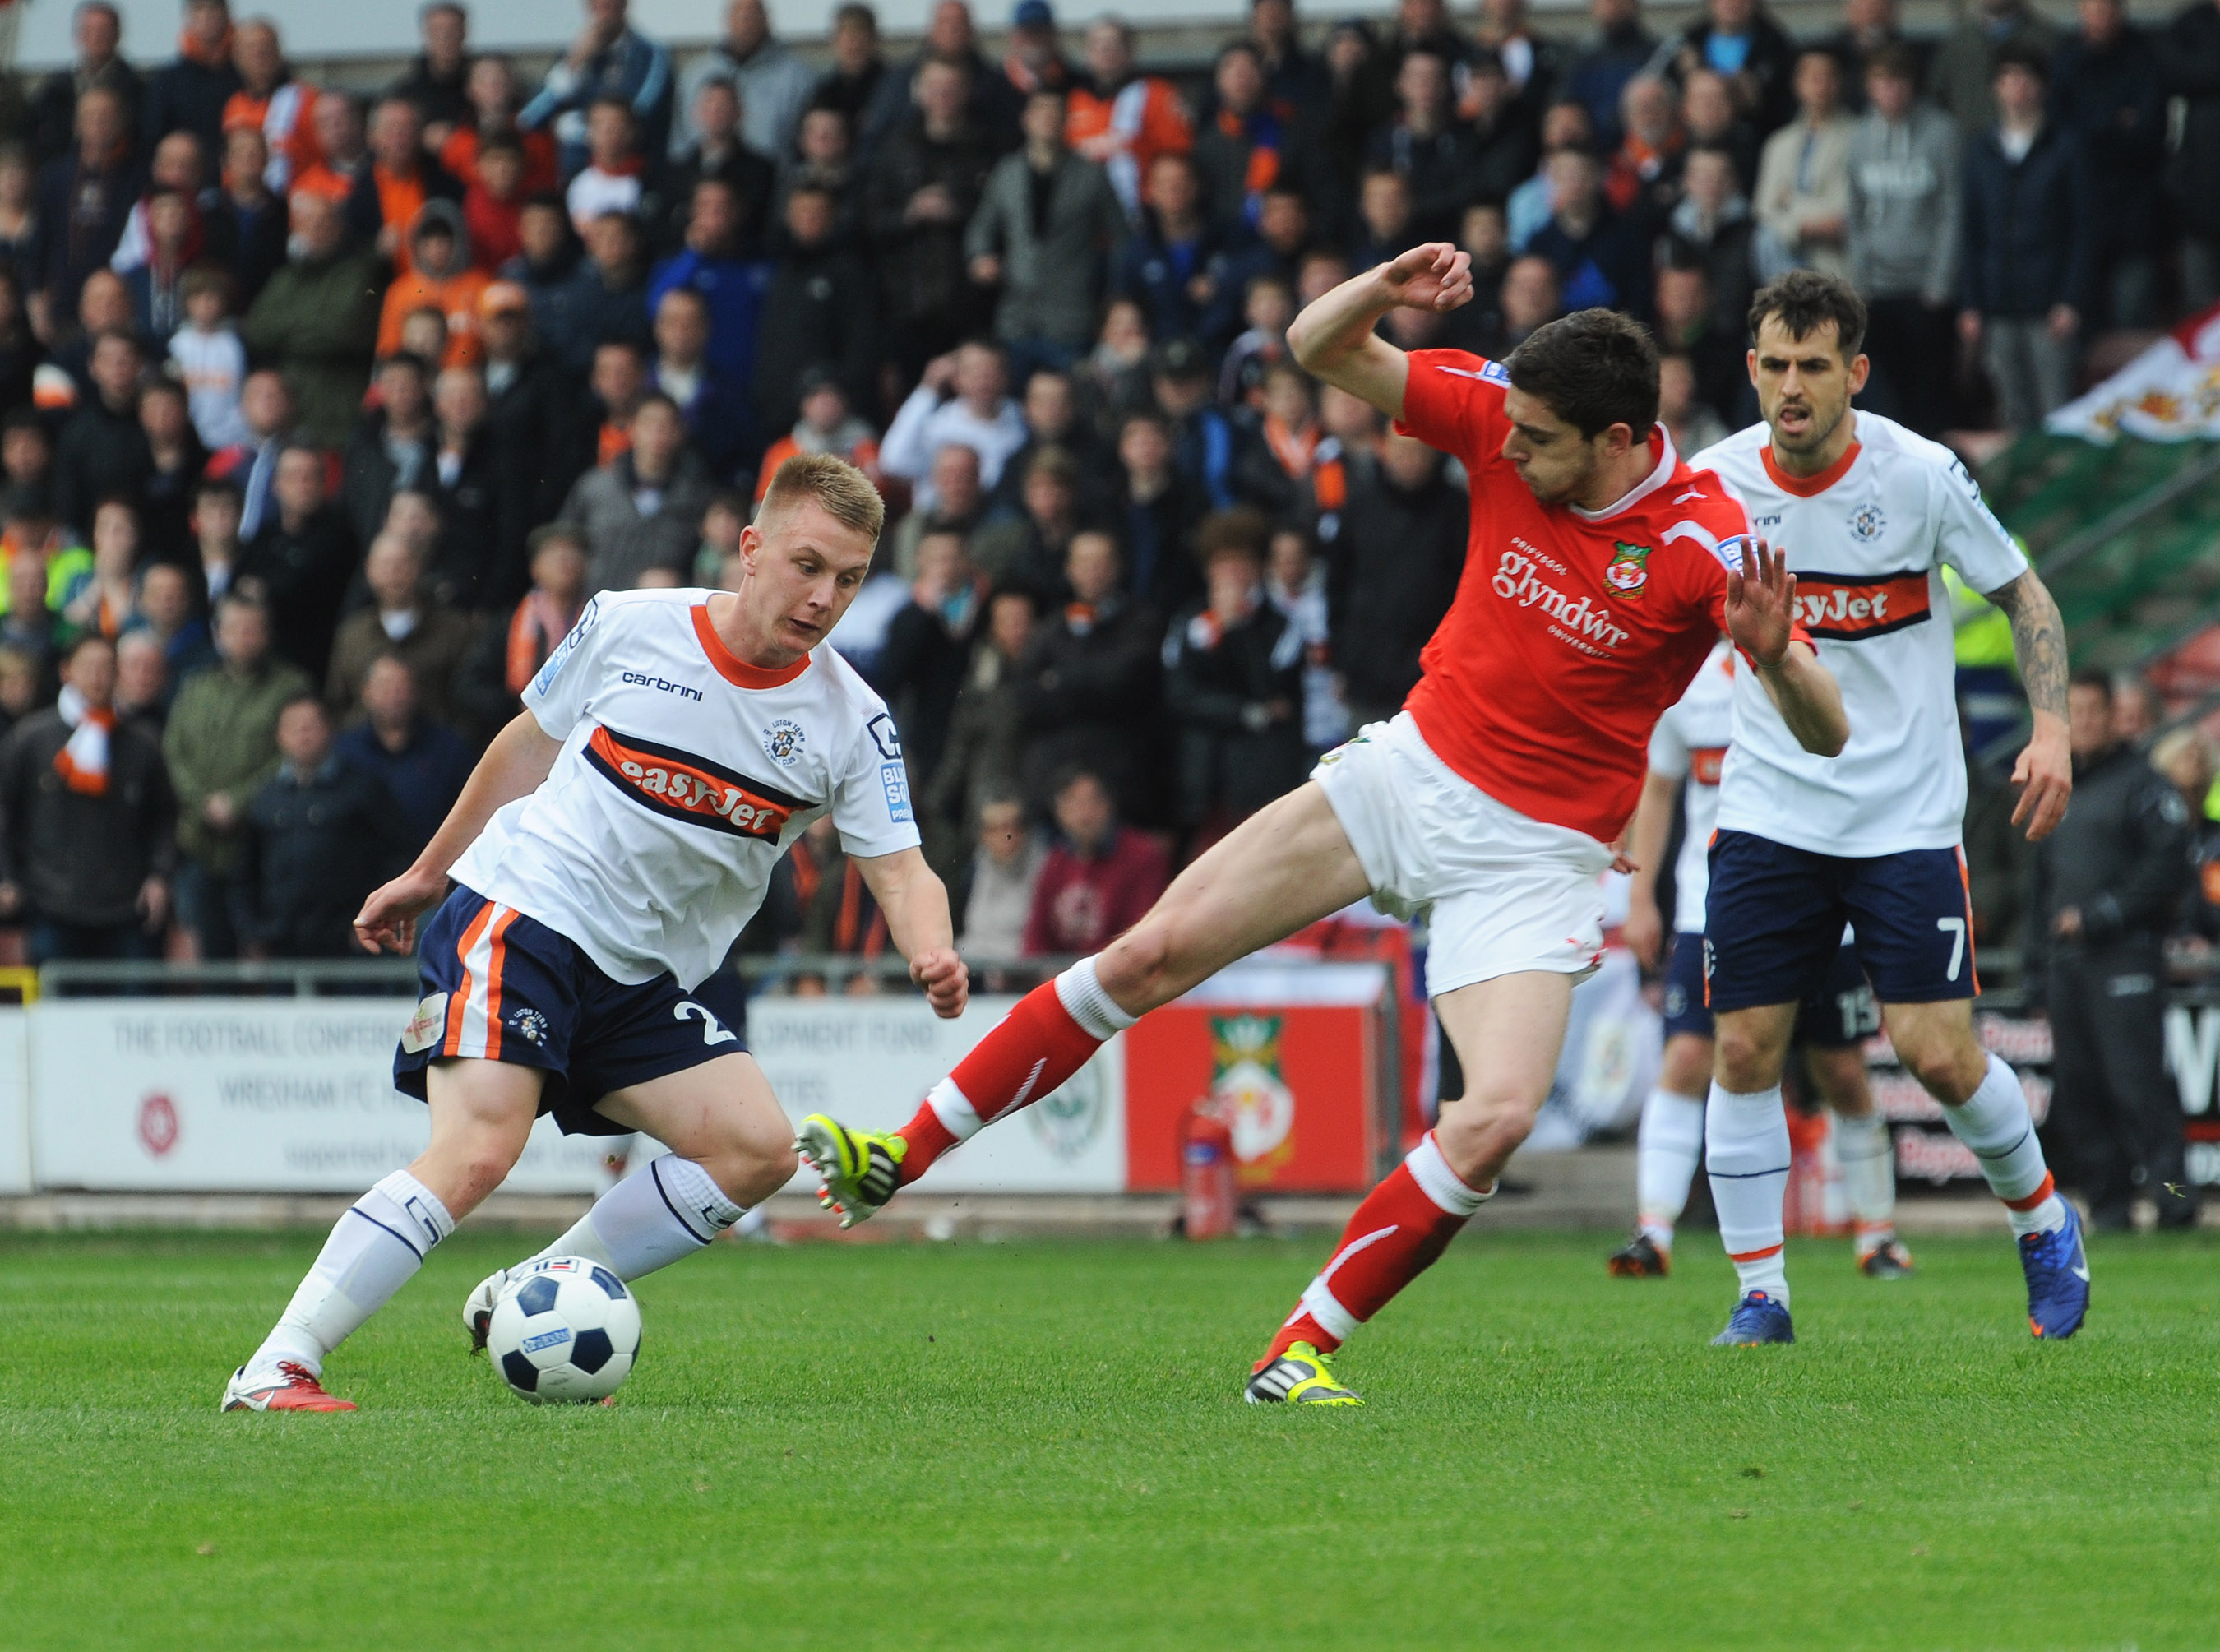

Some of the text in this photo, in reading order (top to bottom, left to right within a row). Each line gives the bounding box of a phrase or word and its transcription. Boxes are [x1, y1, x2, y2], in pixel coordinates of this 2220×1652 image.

[1752, 513, 1782, 526] rini
[1492, 550, 1630, 649] glyndŵr
[1792, 589, 1889, 626] syJet
[1547, 624, 1613, 659] UNIVERSITY
[622, 671, 704, 702] carbrini
[771, 719, 792, 729] LUTON
[619, 759, 775, 836] easyJet
[1937, 917, 1966, 981] 7
[115, 1018, 159, 1056] THE
[165, 1018, 286, 1056] FOOTBALL
[217, 1071, 335, 1111] WREXHAM
